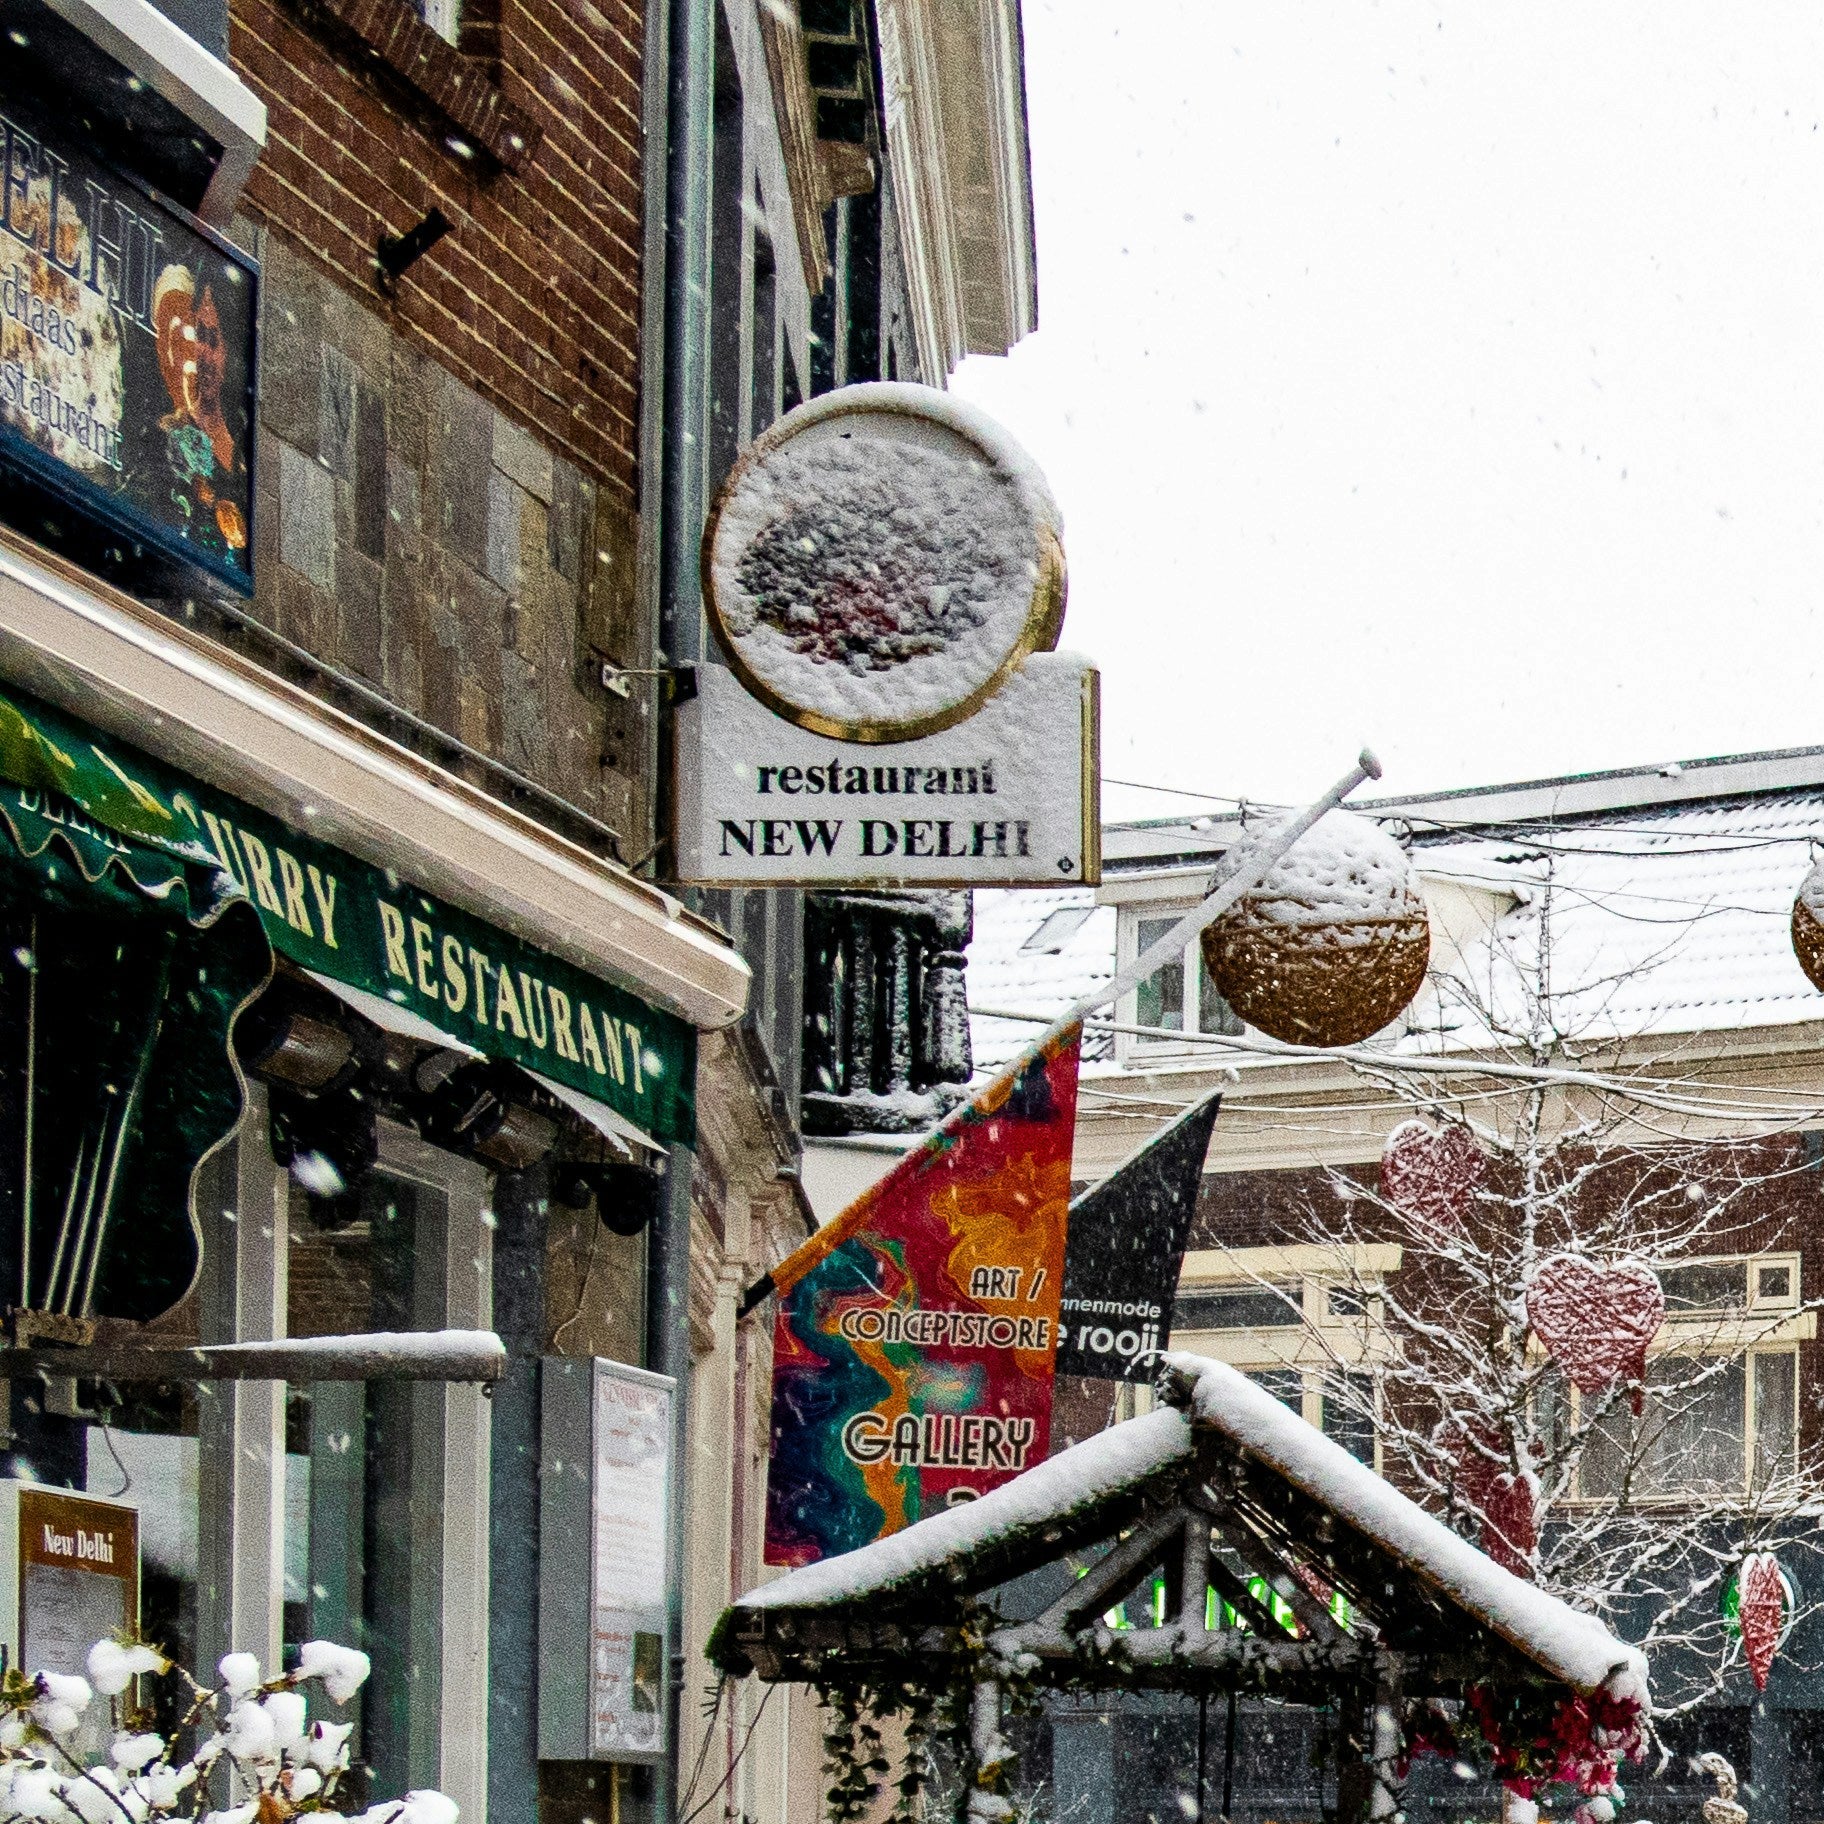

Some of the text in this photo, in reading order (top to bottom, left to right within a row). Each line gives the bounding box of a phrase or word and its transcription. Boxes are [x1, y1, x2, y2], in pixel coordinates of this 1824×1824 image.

[756, 757, 998, 795] restaurant
[717, 819, 1034, 859] NEW DELHI
[377, 898, 645, 1095] RESTAURANT
[970, 1265, 1021, 1300] ART
[840, 1308, 1053, 1351] CONCEPTSTORE
[1077, 1322, 1160, 1367] rooij
[842, 1411, 1035, 1470] GALLERY
[43, 1523, 114, 1564] New Delhi
